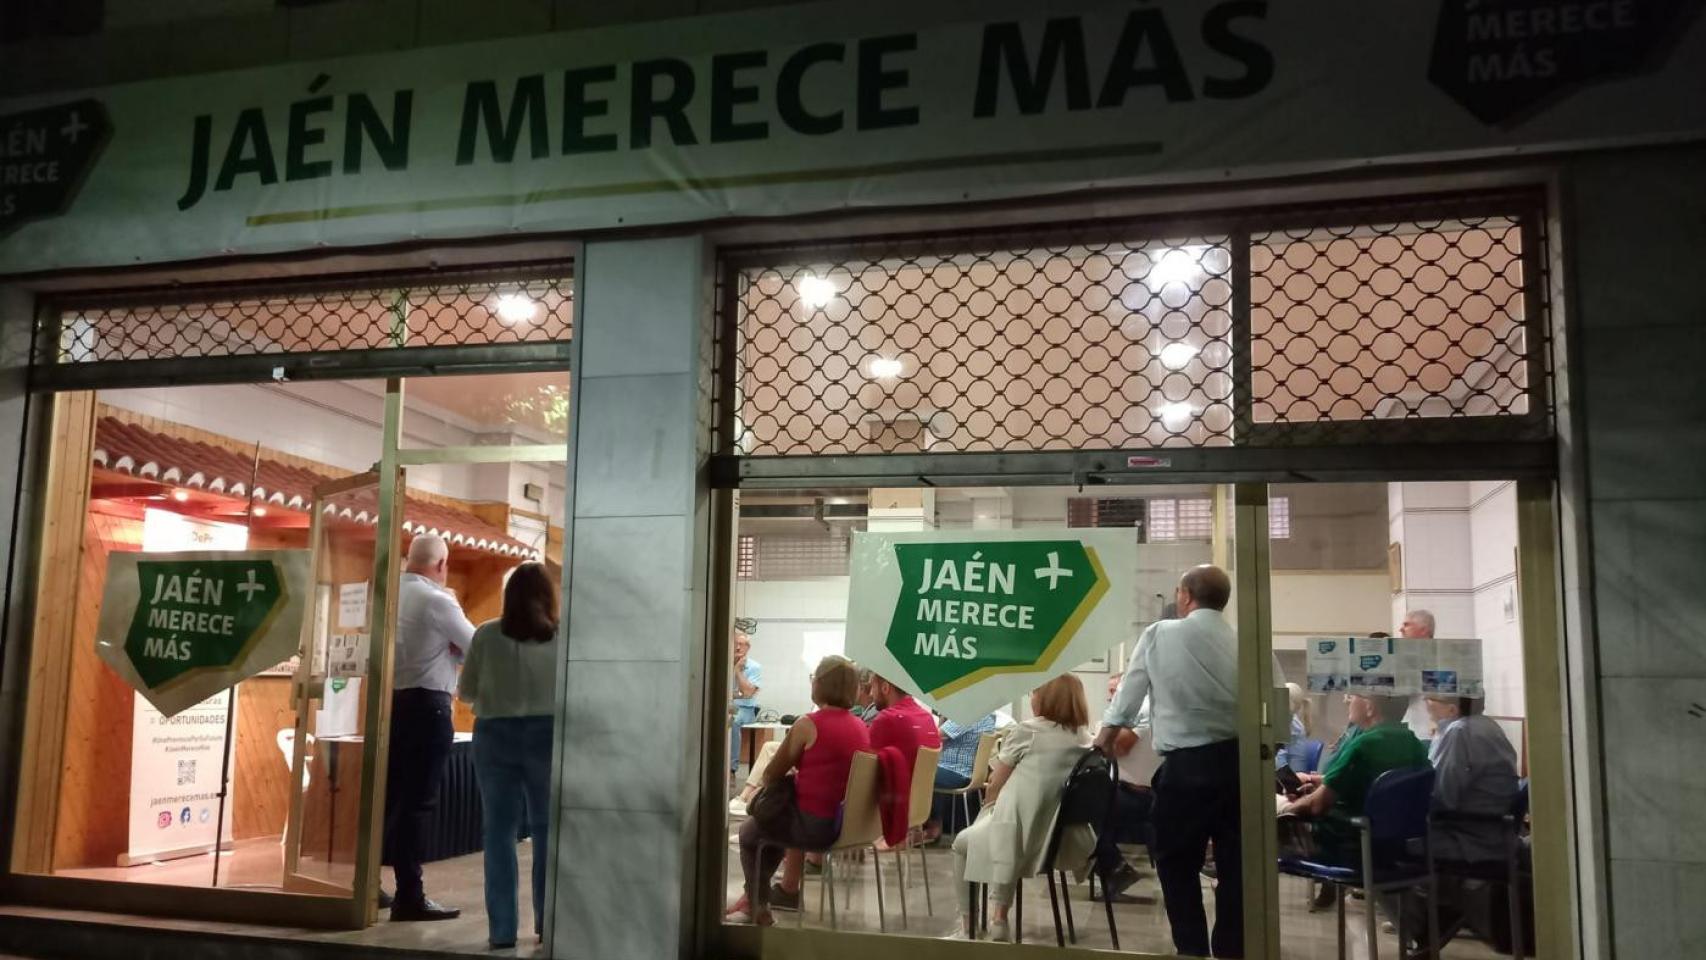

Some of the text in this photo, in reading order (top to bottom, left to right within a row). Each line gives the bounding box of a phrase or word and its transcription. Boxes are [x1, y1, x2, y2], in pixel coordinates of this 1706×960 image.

[1466, 0, 1636, 41] MERECE
[1467, 41, 1557, 82] MÁS
[177, 74, 412, 211] JAÉN
[456, 33, 919, 165] MERECE
[150, 569, 224, 606] JAÉN
[917, 551, 1015, 594] JAÉN
[148, 608, 234, 636] MERECE
[917, 598, 1035, 630] MERECE
[143, 634, 191, 661] MÁS
[914, 628, 977, 660] MÁS
[159, 714, 225, 726] OPORTUNIDADES
